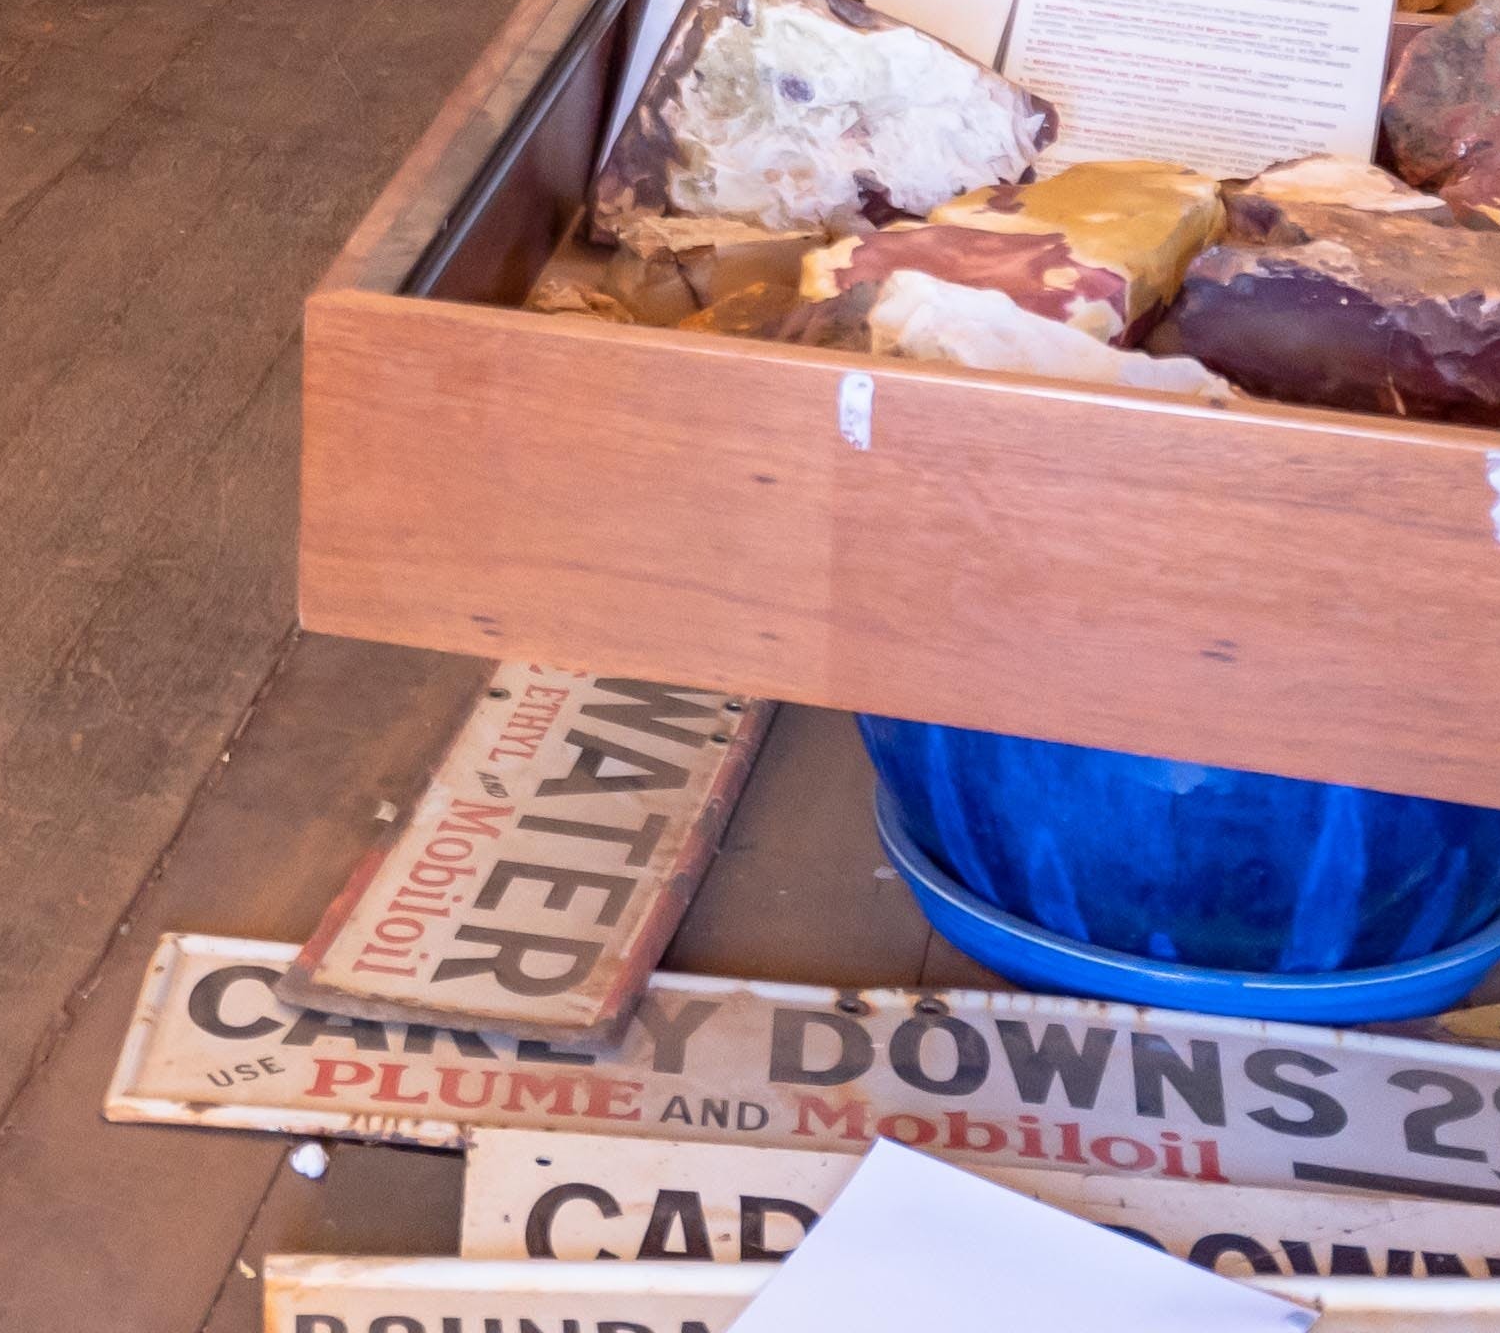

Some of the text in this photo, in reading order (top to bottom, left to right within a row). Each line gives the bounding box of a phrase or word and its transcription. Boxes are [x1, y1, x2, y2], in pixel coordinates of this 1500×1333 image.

[351, 683, 570, 979] ETHYL AND Mobiloil
[430, 677, 727, 999] WATER
[206, 1055, 1231, 1183] USE PLUME AND Mobiloil
[768, 1006, 1348, 1137] DOWNS
